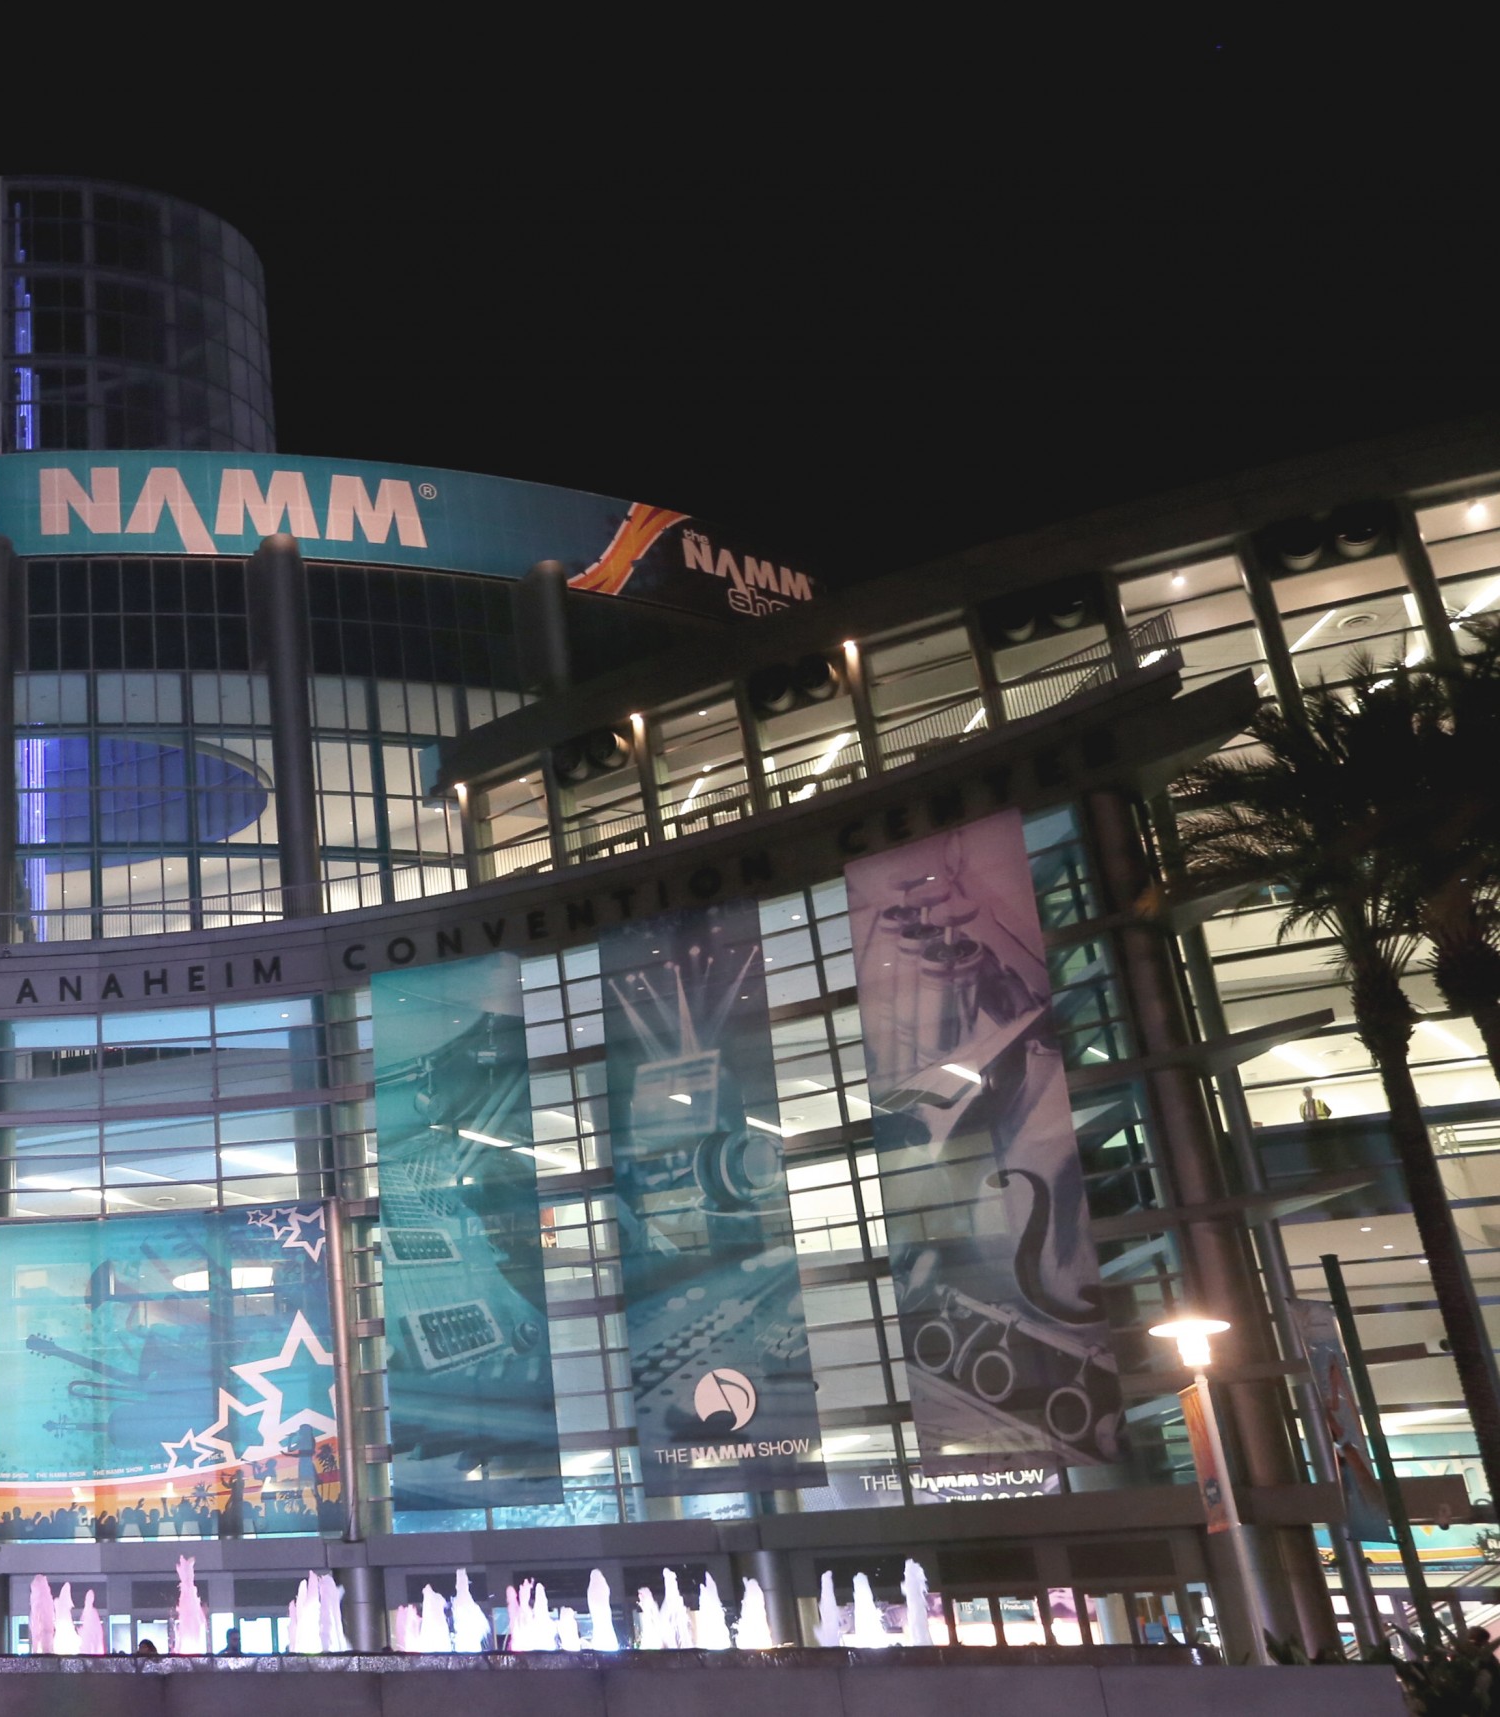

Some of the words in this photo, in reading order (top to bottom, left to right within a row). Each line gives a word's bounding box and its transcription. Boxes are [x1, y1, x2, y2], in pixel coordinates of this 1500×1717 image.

[683, 529, 710, 545] the
[15, 955, 284, 1005] ANAHEIM
[342, 849, 773, 972] CONVENTION
[654, 1448, 689, 1464] THE
[757, 1438, 810, 1457] SHOW
[860, 1474, 902, 1491] THE
[982, 1469, 1044, 1486] SHOW
